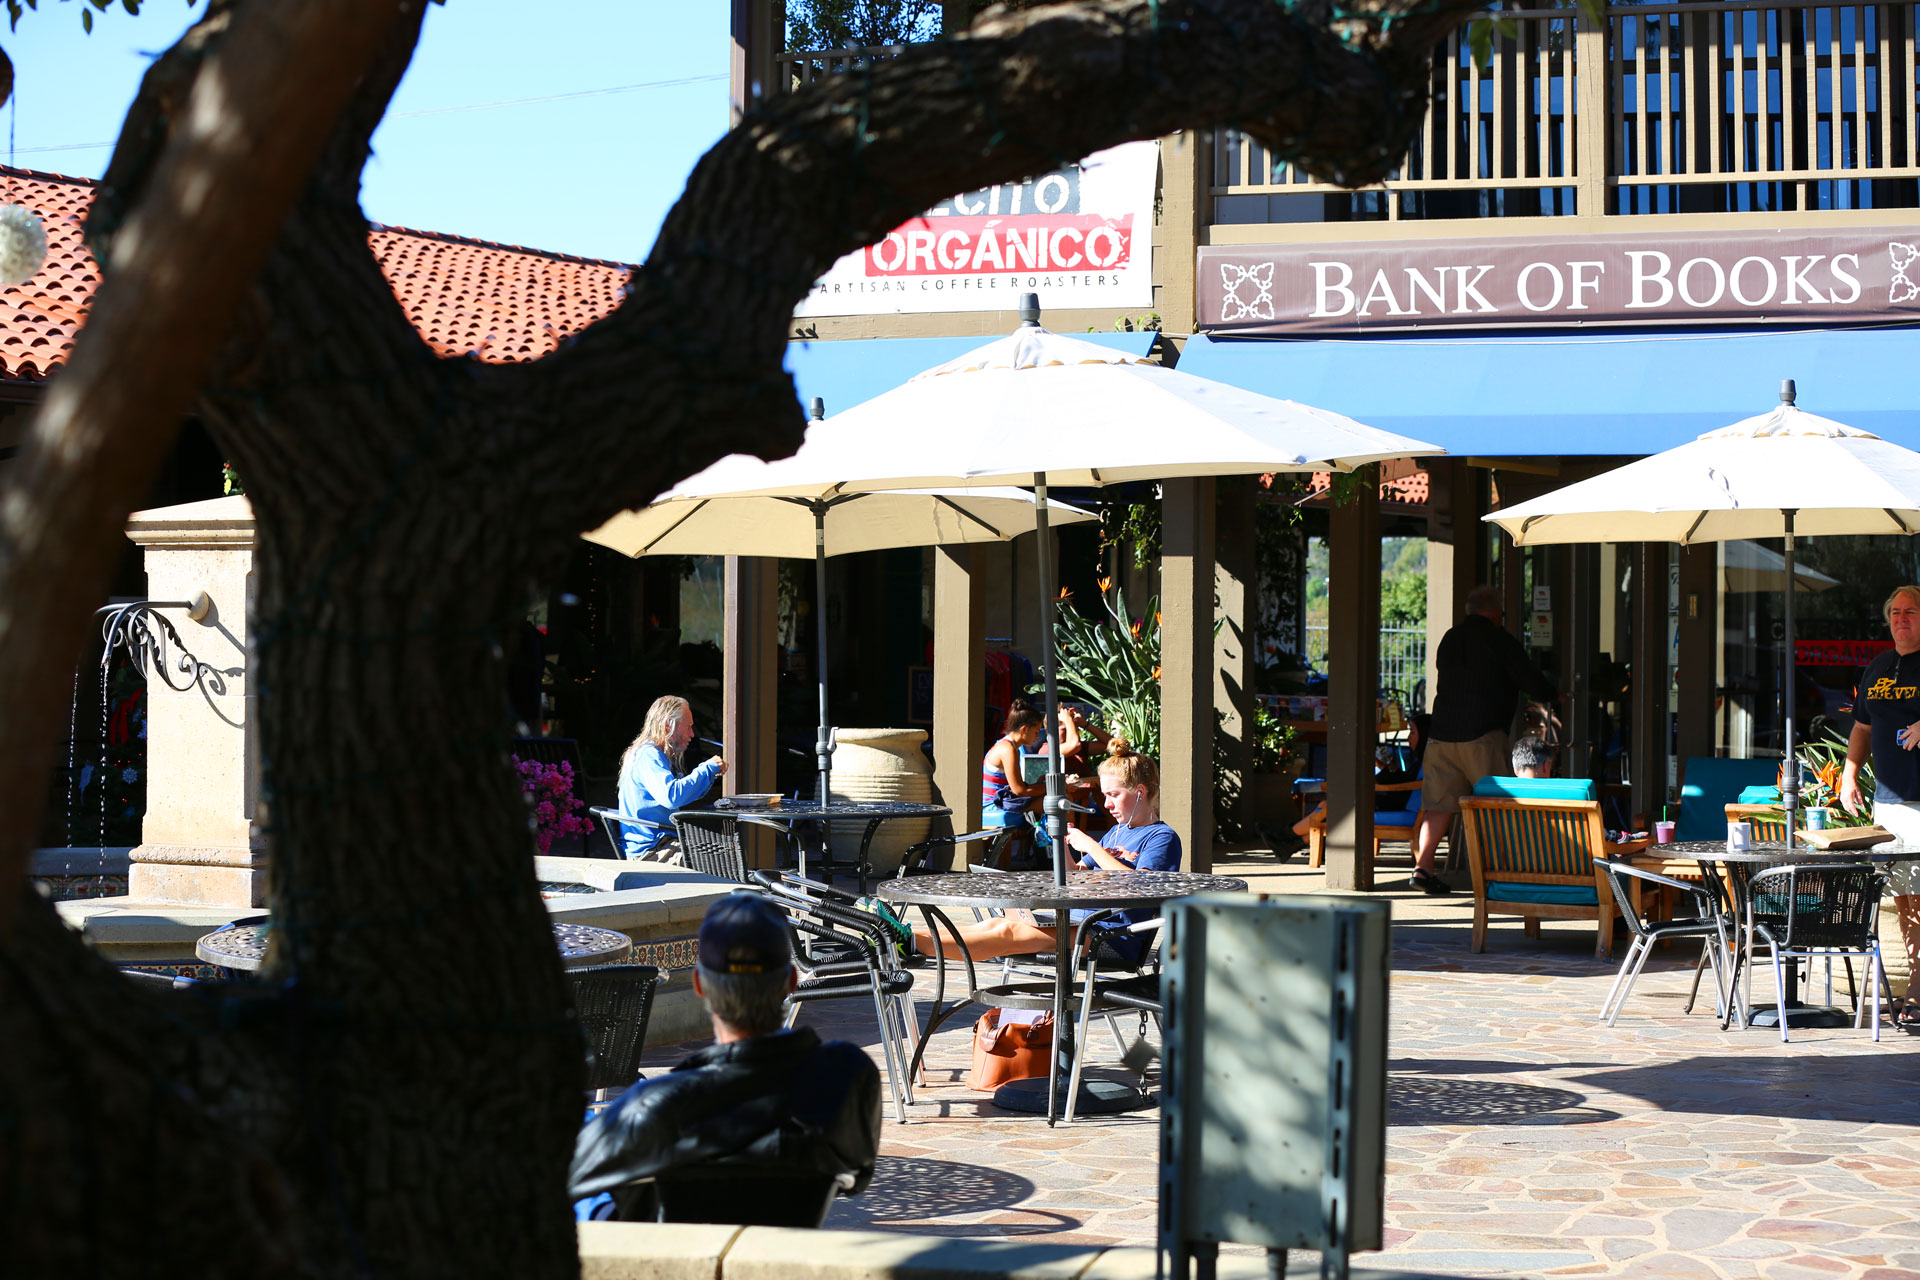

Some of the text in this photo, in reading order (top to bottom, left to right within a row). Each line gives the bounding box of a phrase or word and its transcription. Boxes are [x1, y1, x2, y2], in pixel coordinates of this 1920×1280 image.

[872, 219, 1123, 272] ORGÁNICO
[820, 274, 1121, 294] ARTISAN COFFEE ROASTERS
